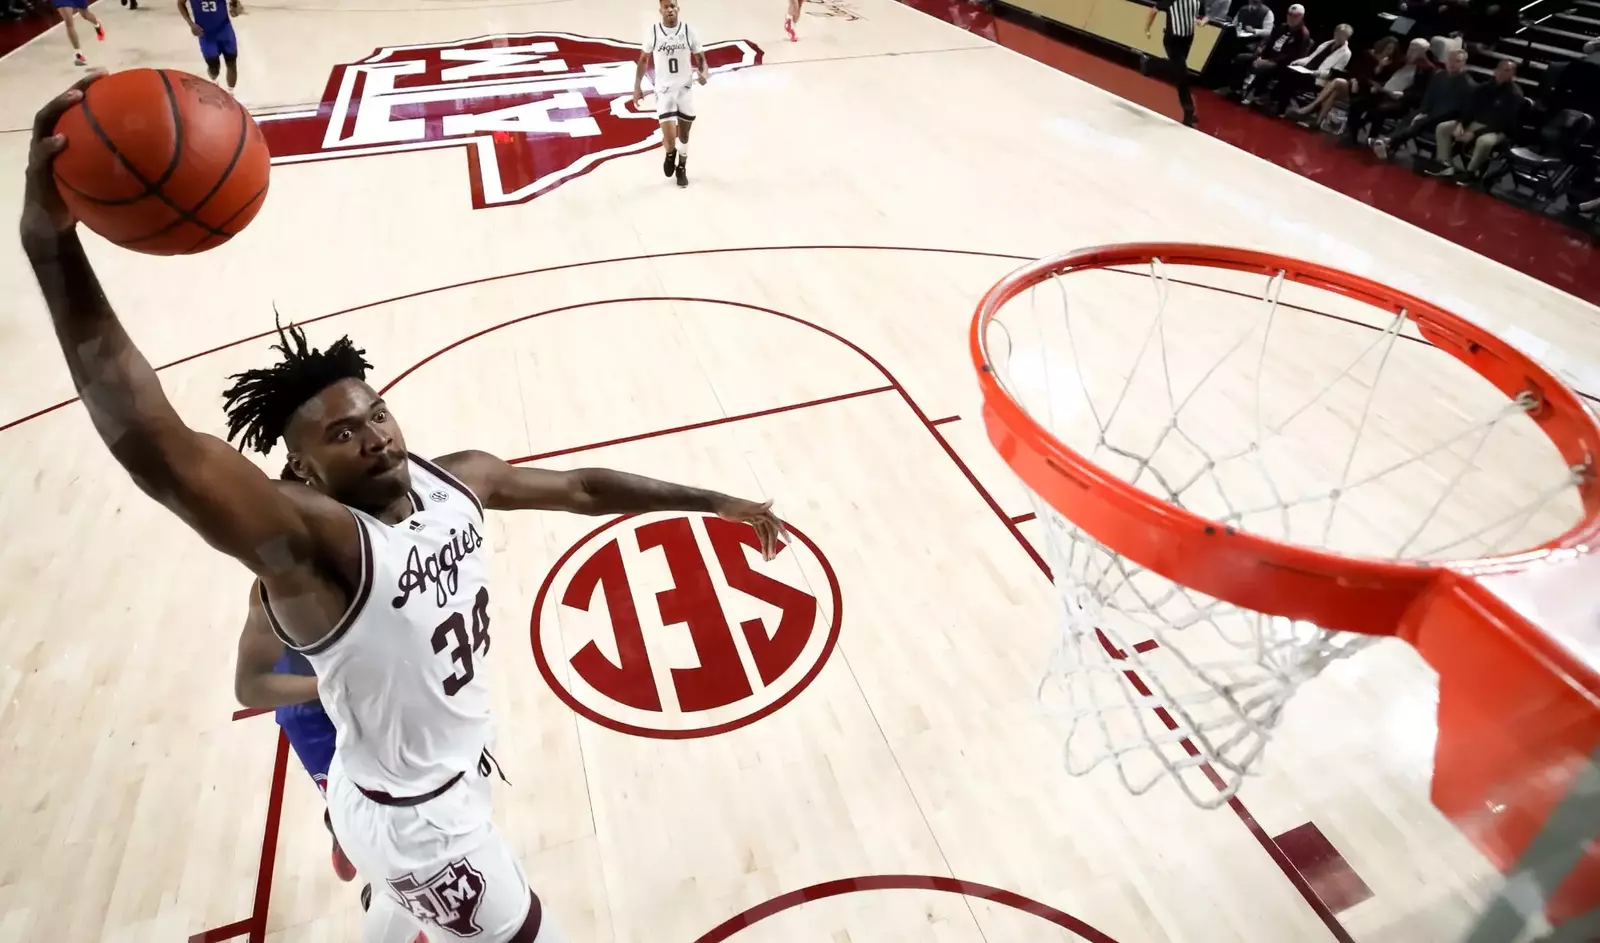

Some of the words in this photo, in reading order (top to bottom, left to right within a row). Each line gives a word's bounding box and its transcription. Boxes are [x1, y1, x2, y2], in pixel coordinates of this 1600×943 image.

[201, 1, 217, 12] 23
[657, 42, 686, 56] Aggies
[668, 58, 679, 73] 0
[391, 522, 483, 609] Aggies
[562, 515, 816, 713] SEC
[430, 586, 491, 697] 34
